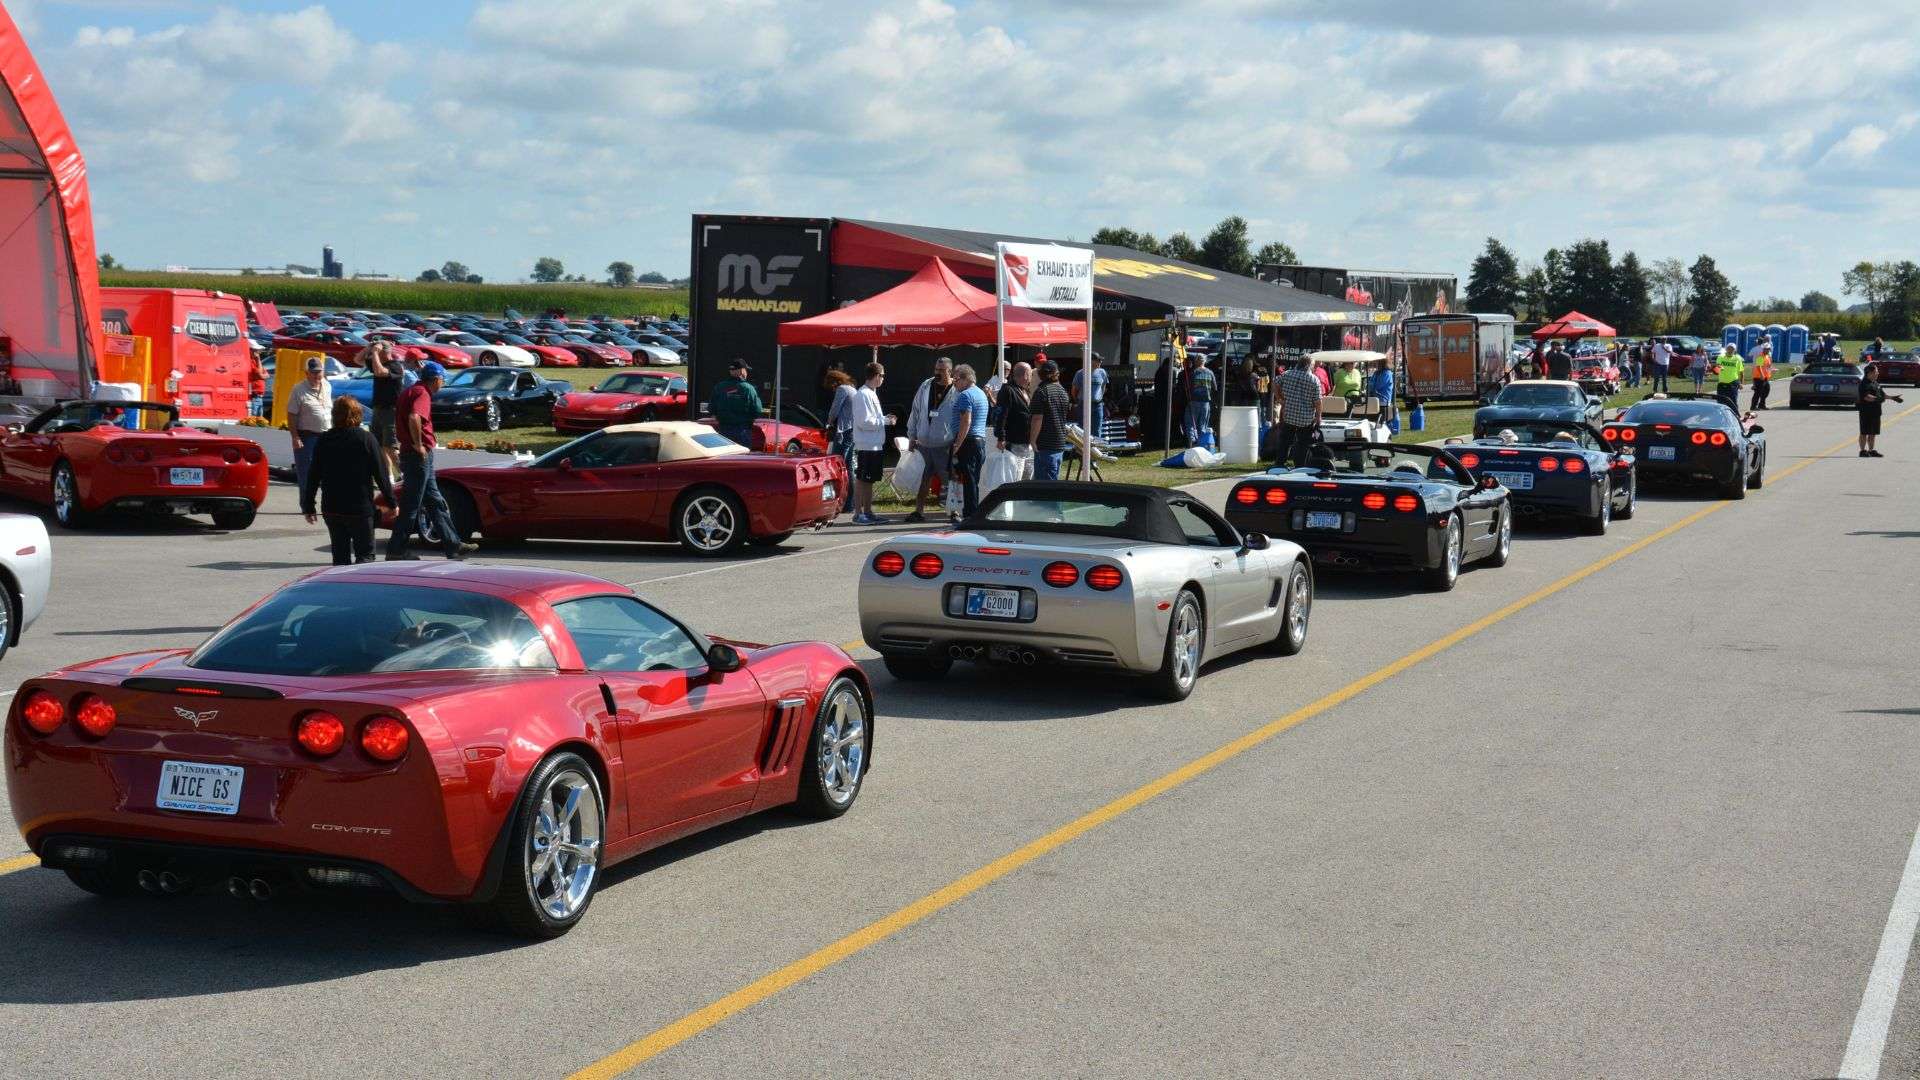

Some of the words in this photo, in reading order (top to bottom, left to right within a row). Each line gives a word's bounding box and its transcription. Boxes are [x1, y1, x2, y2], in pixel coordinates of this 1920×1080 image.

[1037, 260, 1068, 278] EXHAUST
[1049, 286, 1078, 302] INSTALLS
[717, 298, 802, 313] MAGNAFLOW
[952, 565, 1031, 576] CORVETTE
[986, 596, 1013, 610] G2000
[184, 765, 222, 775] INDIANA
[170, 775, 205, 798] NICE
[212, 779, 230, 799] GS
[163, 801, 197, 809] GRAND
[197, 804, 232, 812] SPORT
[311, 823, 392, 835] CORVETTE
